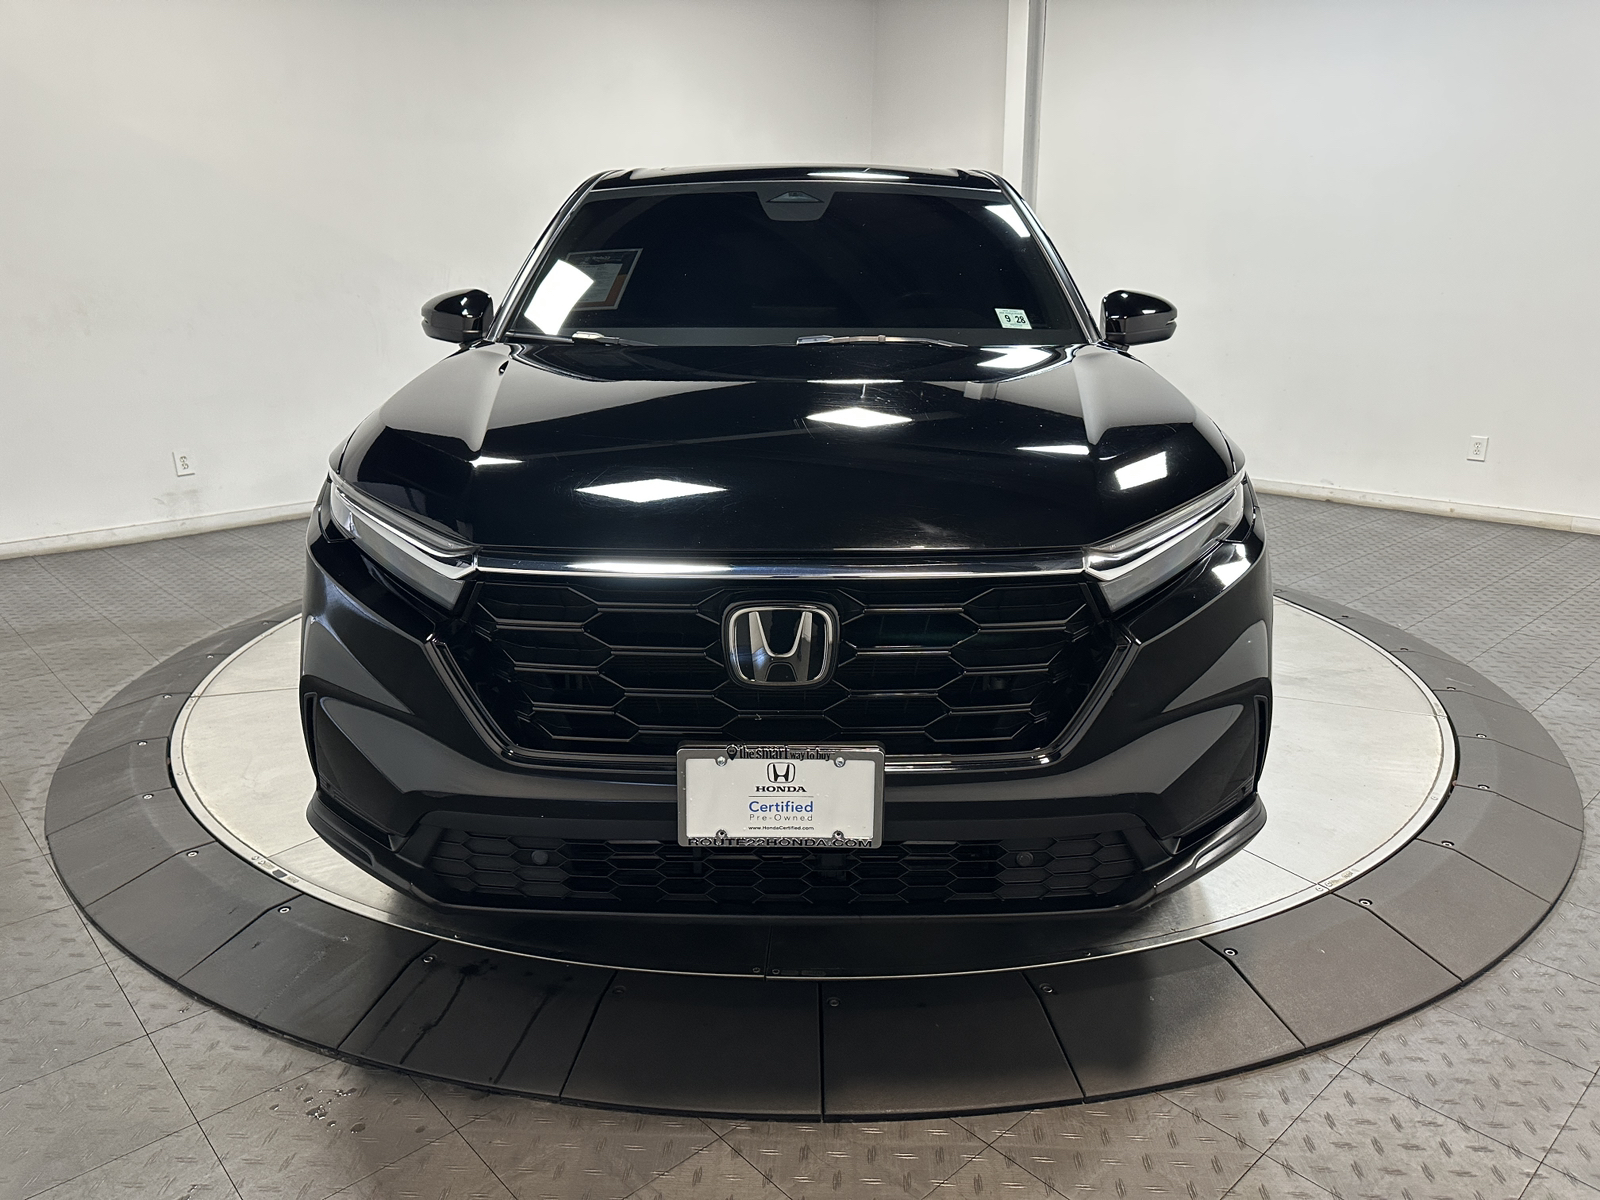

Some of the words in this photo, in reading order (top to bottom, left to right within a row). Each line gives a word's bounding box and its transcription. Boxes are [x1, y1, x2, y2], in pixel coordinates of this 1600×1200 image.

[1004, 314, 1011, 323] 9
[1014, 315, 1026, 324] 28
[739, 746, 755, 759] the
[755, 746, 789, 759] smart
[789, 751, 804, 761] way
[806, 749, 815, 759] to
[816, 748, 831, 761] buy
[749, 801, 813, 812] Certified
[749, 814, 813, 822] Pre-Owned
[687, 838, 872, 848] ROUTE22HONDA.COM
